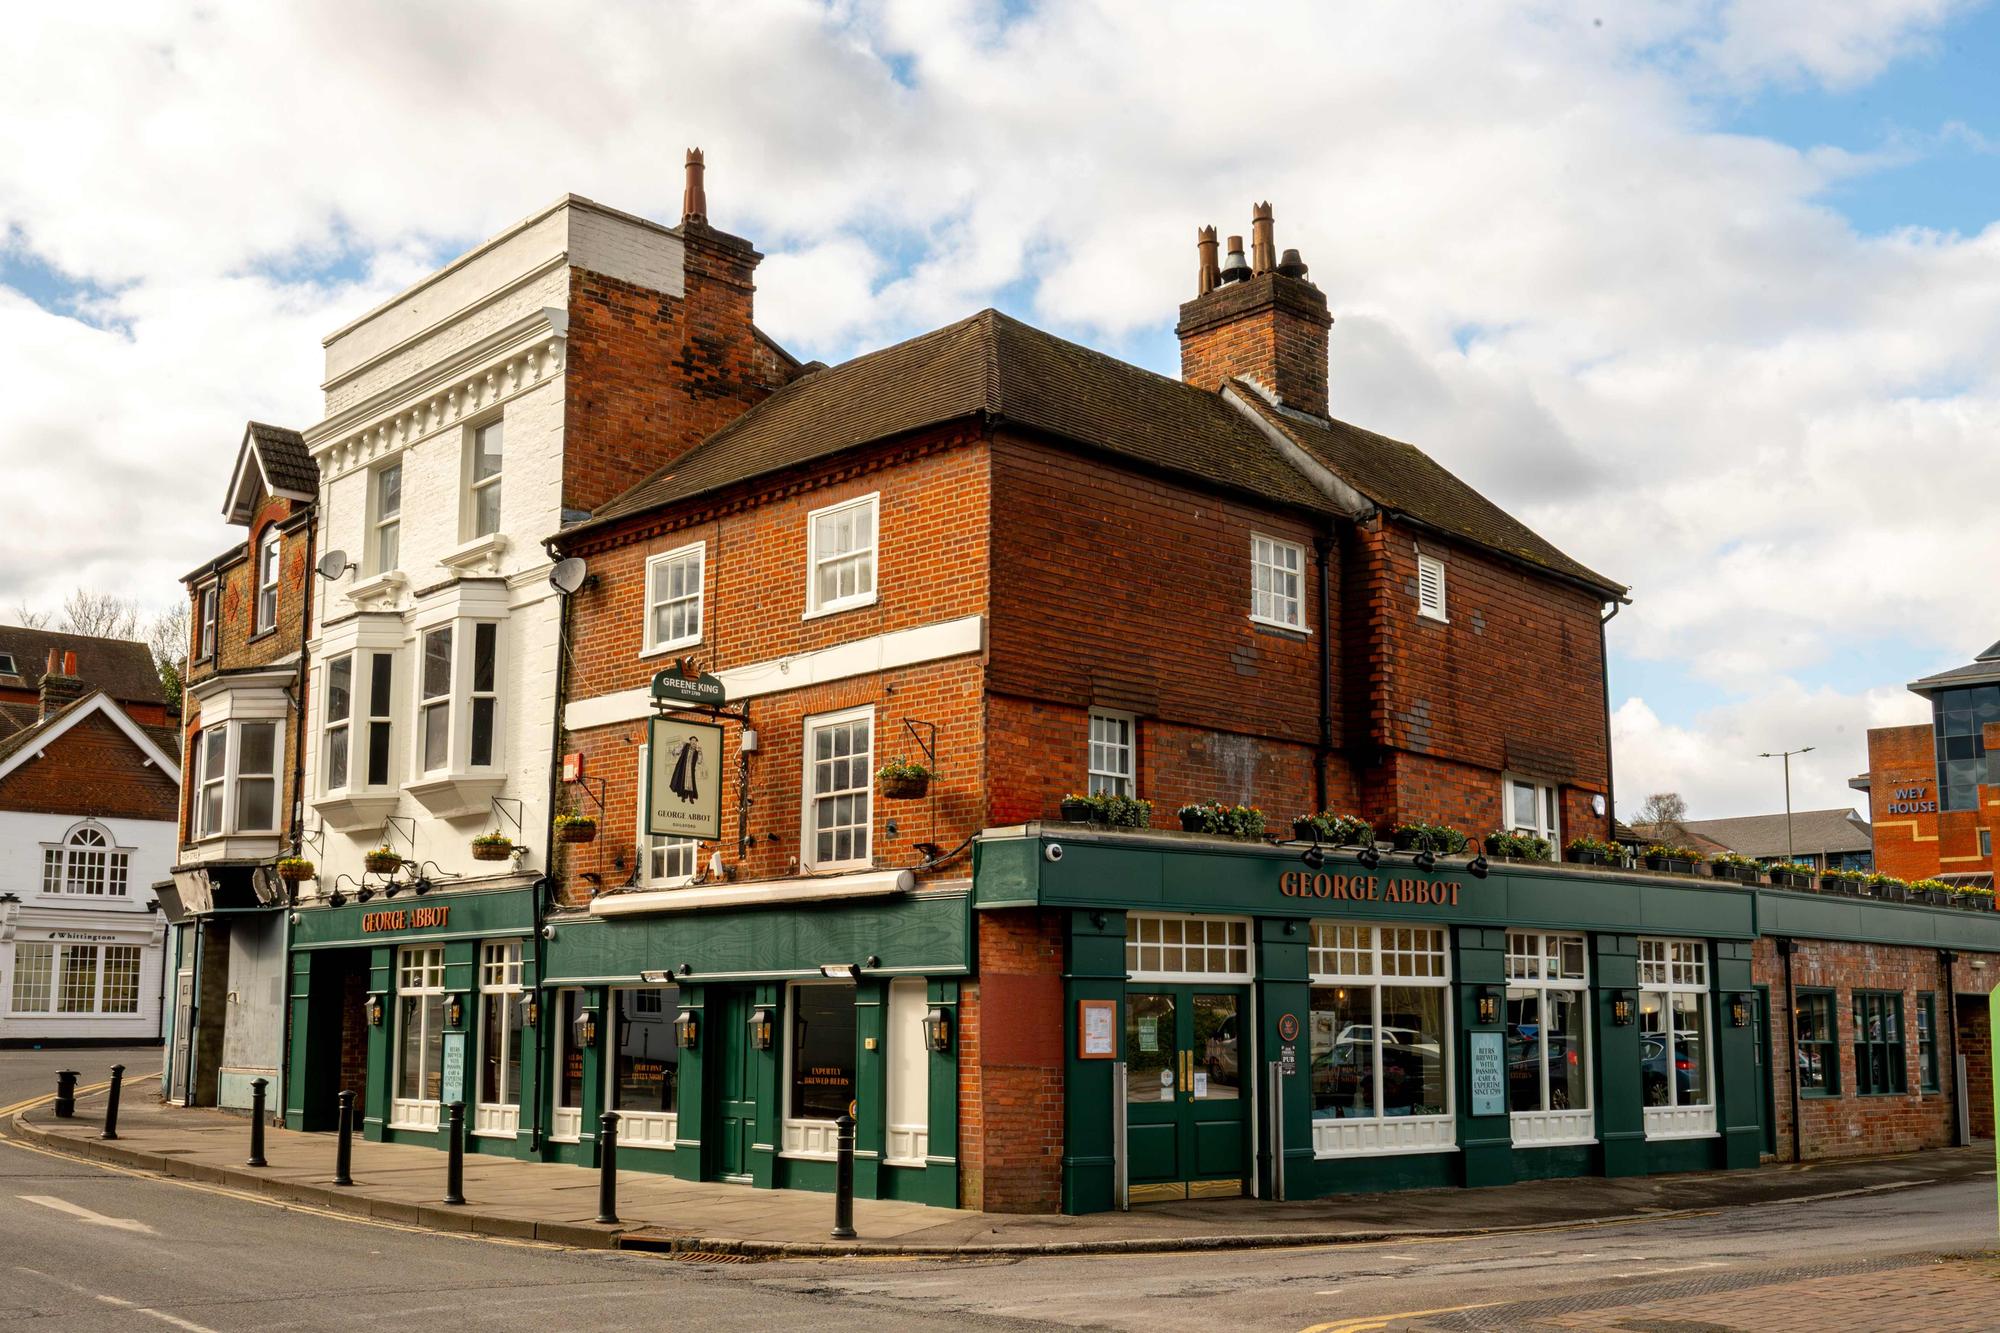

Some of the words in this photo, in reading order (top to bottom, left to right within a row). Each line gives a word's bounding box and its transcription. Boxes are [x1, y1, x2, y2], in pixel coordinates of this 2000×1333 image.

[663, 677, 697, 691] GREENE
[698, 683, 719, 694] KING
[1895, 787, 1926, 800] WEY
[1888, 801, 1936, 814] HOUSE
[657, 809, 686, 819] GEORGE
[687, 813, 711, 822] ABBOT
[1280, 871, 1379, 901] GEORGE
[1385, 878, 1462, 906] ABBOT
[362, 909, 407, 932] GEORGE
[409, 905, 450, 929] ABBOT
[58, 932, 116, 941] Whittingtons
[811, 1067, 841, 1075] EXPERTLY
[804, 1077, 829, 1085] BREWED
[830, 1077, 849, 1086] BEERS
[1474, 1081, 1500, 1089] EXPERTISE
